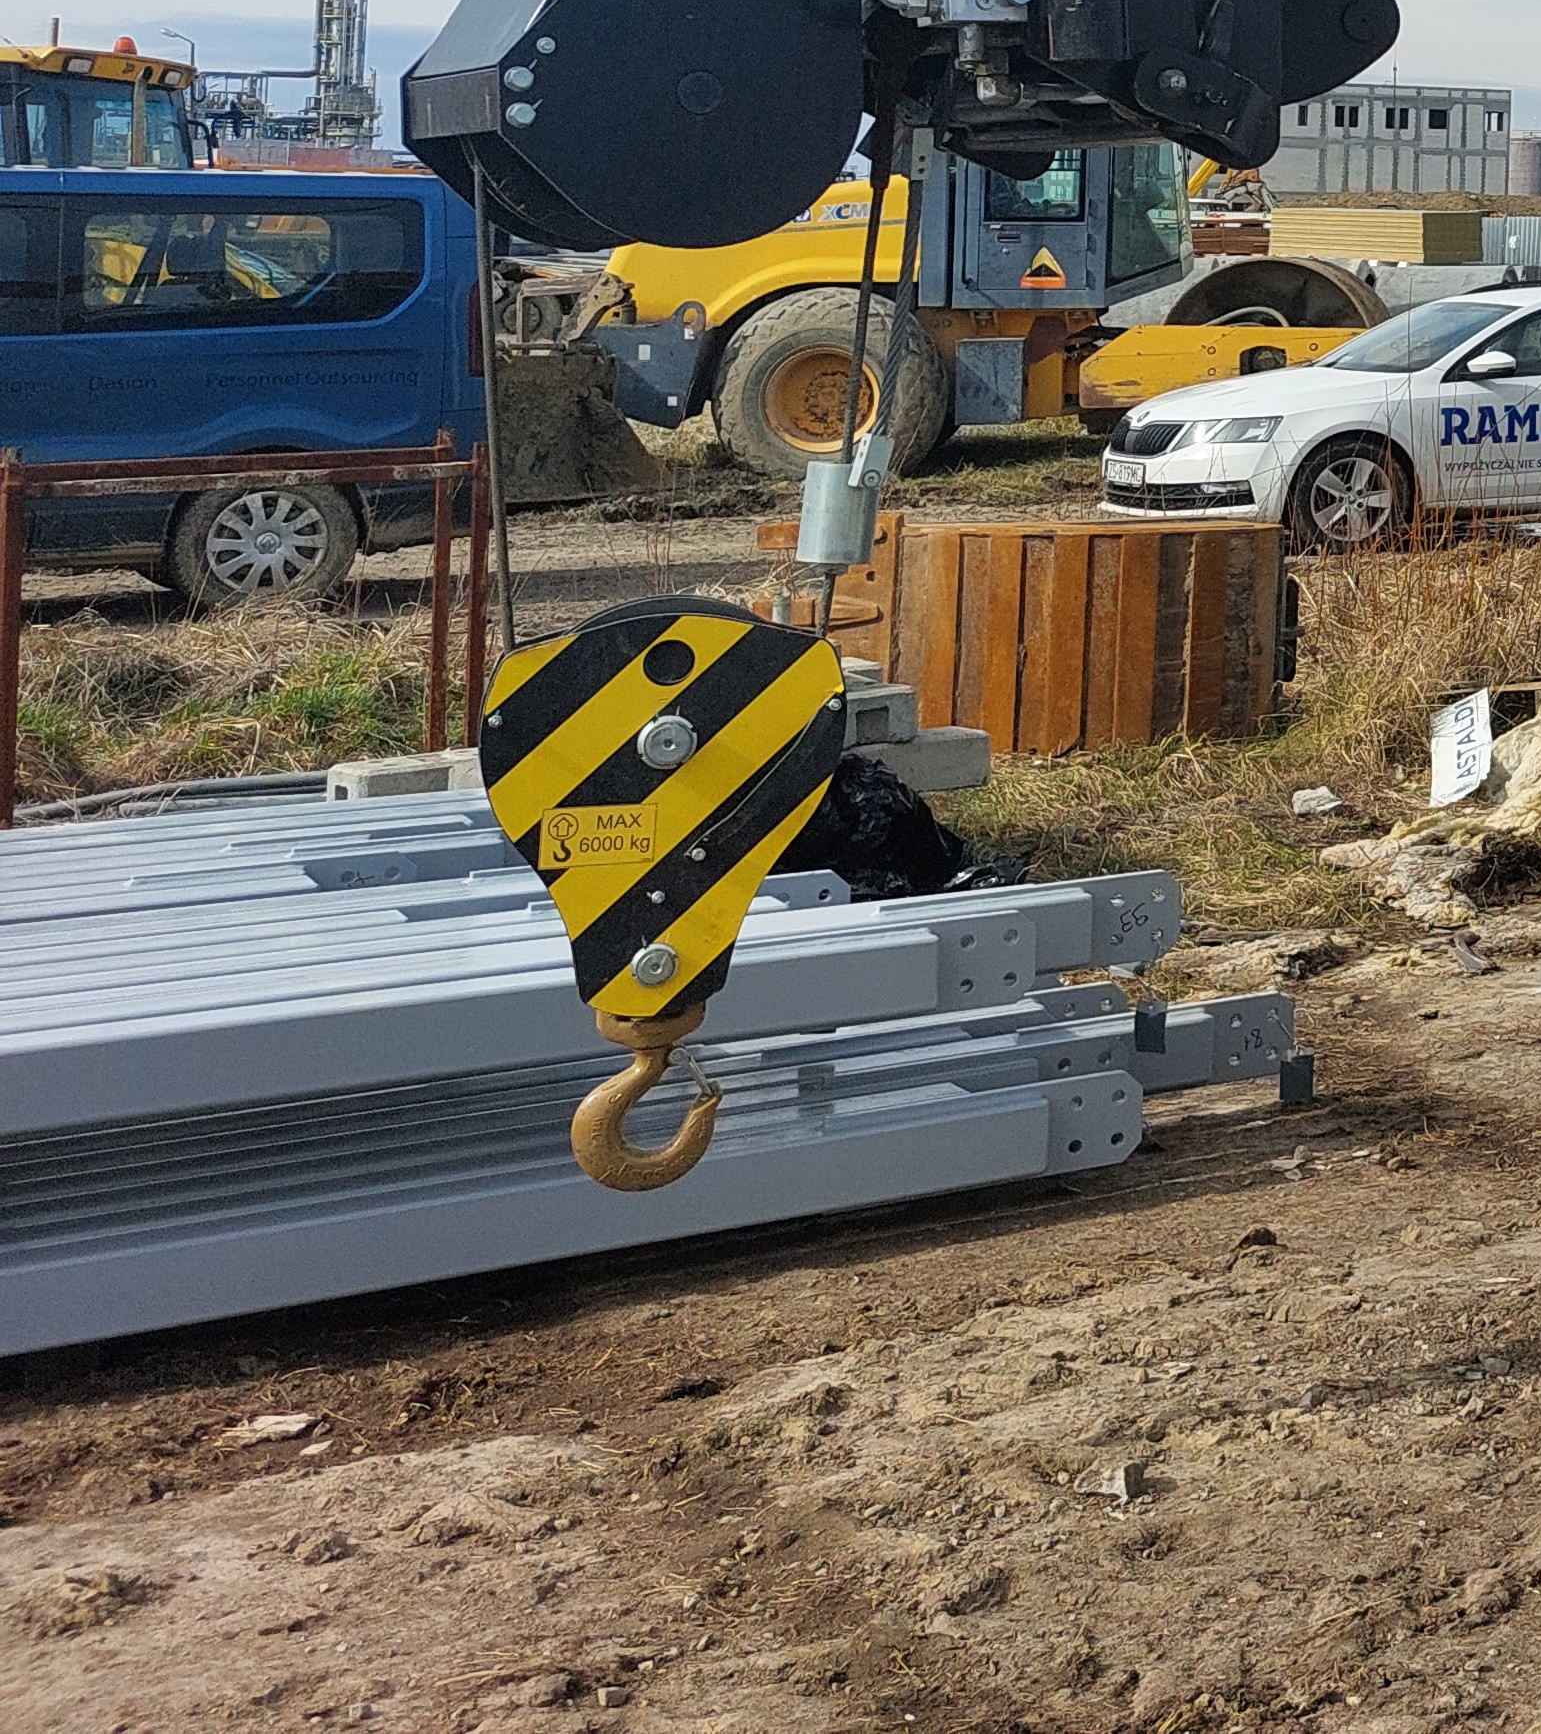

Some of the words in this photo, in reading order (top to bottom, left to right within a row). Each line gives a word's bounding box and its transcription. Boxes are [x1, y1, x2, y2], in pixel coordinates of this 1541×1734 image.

[819, 202, 871, 222] XCM
[596, 812, 643, 831] MAX
[579, 835, 624, 854] 6000
[630, 833, 651, 854] kg
